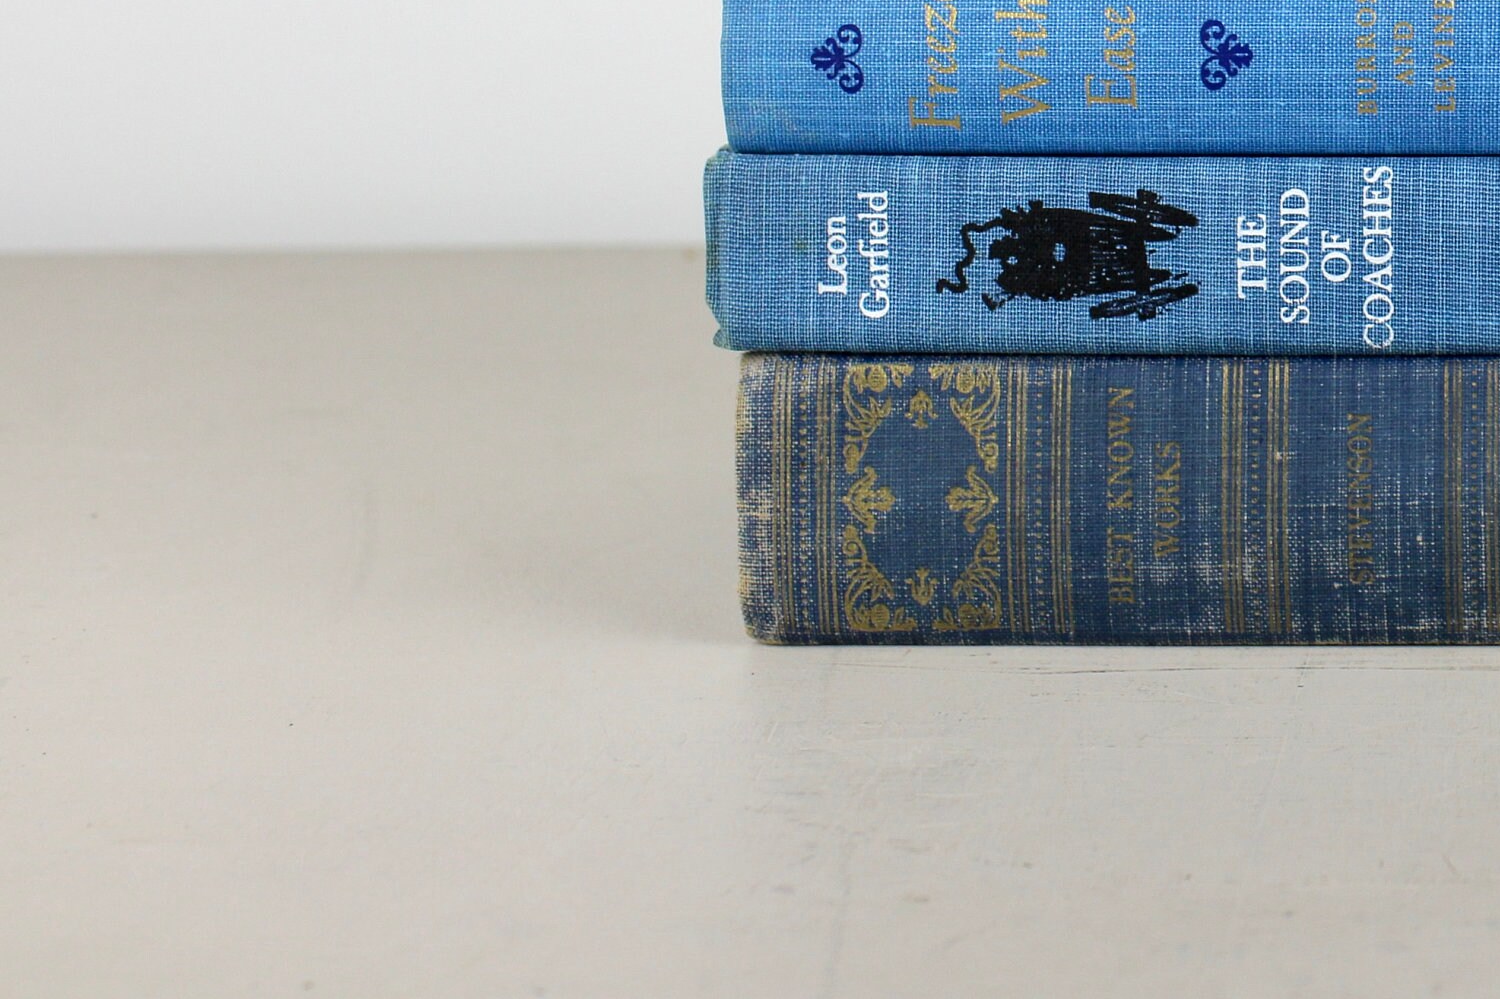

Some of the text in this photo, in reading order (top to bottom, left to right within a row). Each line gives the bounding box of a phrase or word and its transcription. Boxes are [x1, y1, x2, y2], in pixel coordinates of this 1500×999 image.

[1084, 4, 1138, 108] Ease
[1393, 20, 1415, 86] AND
[817, 214, 848, 296] Leon
[858, 190, 890, 319] Garfield
[1237, 212, 1268, 299] THE
[1280, 187, 1311, 325] SOUND
[1320, 229, 1352, 282] OF
[1361, 165, 1395, 350] COACHES
[1107, 386, 1135, 604] BEST KNOWN
[1154, 441, 1182, 558] WORKS
[1347, 412, 1375, 586] STEVENSON
